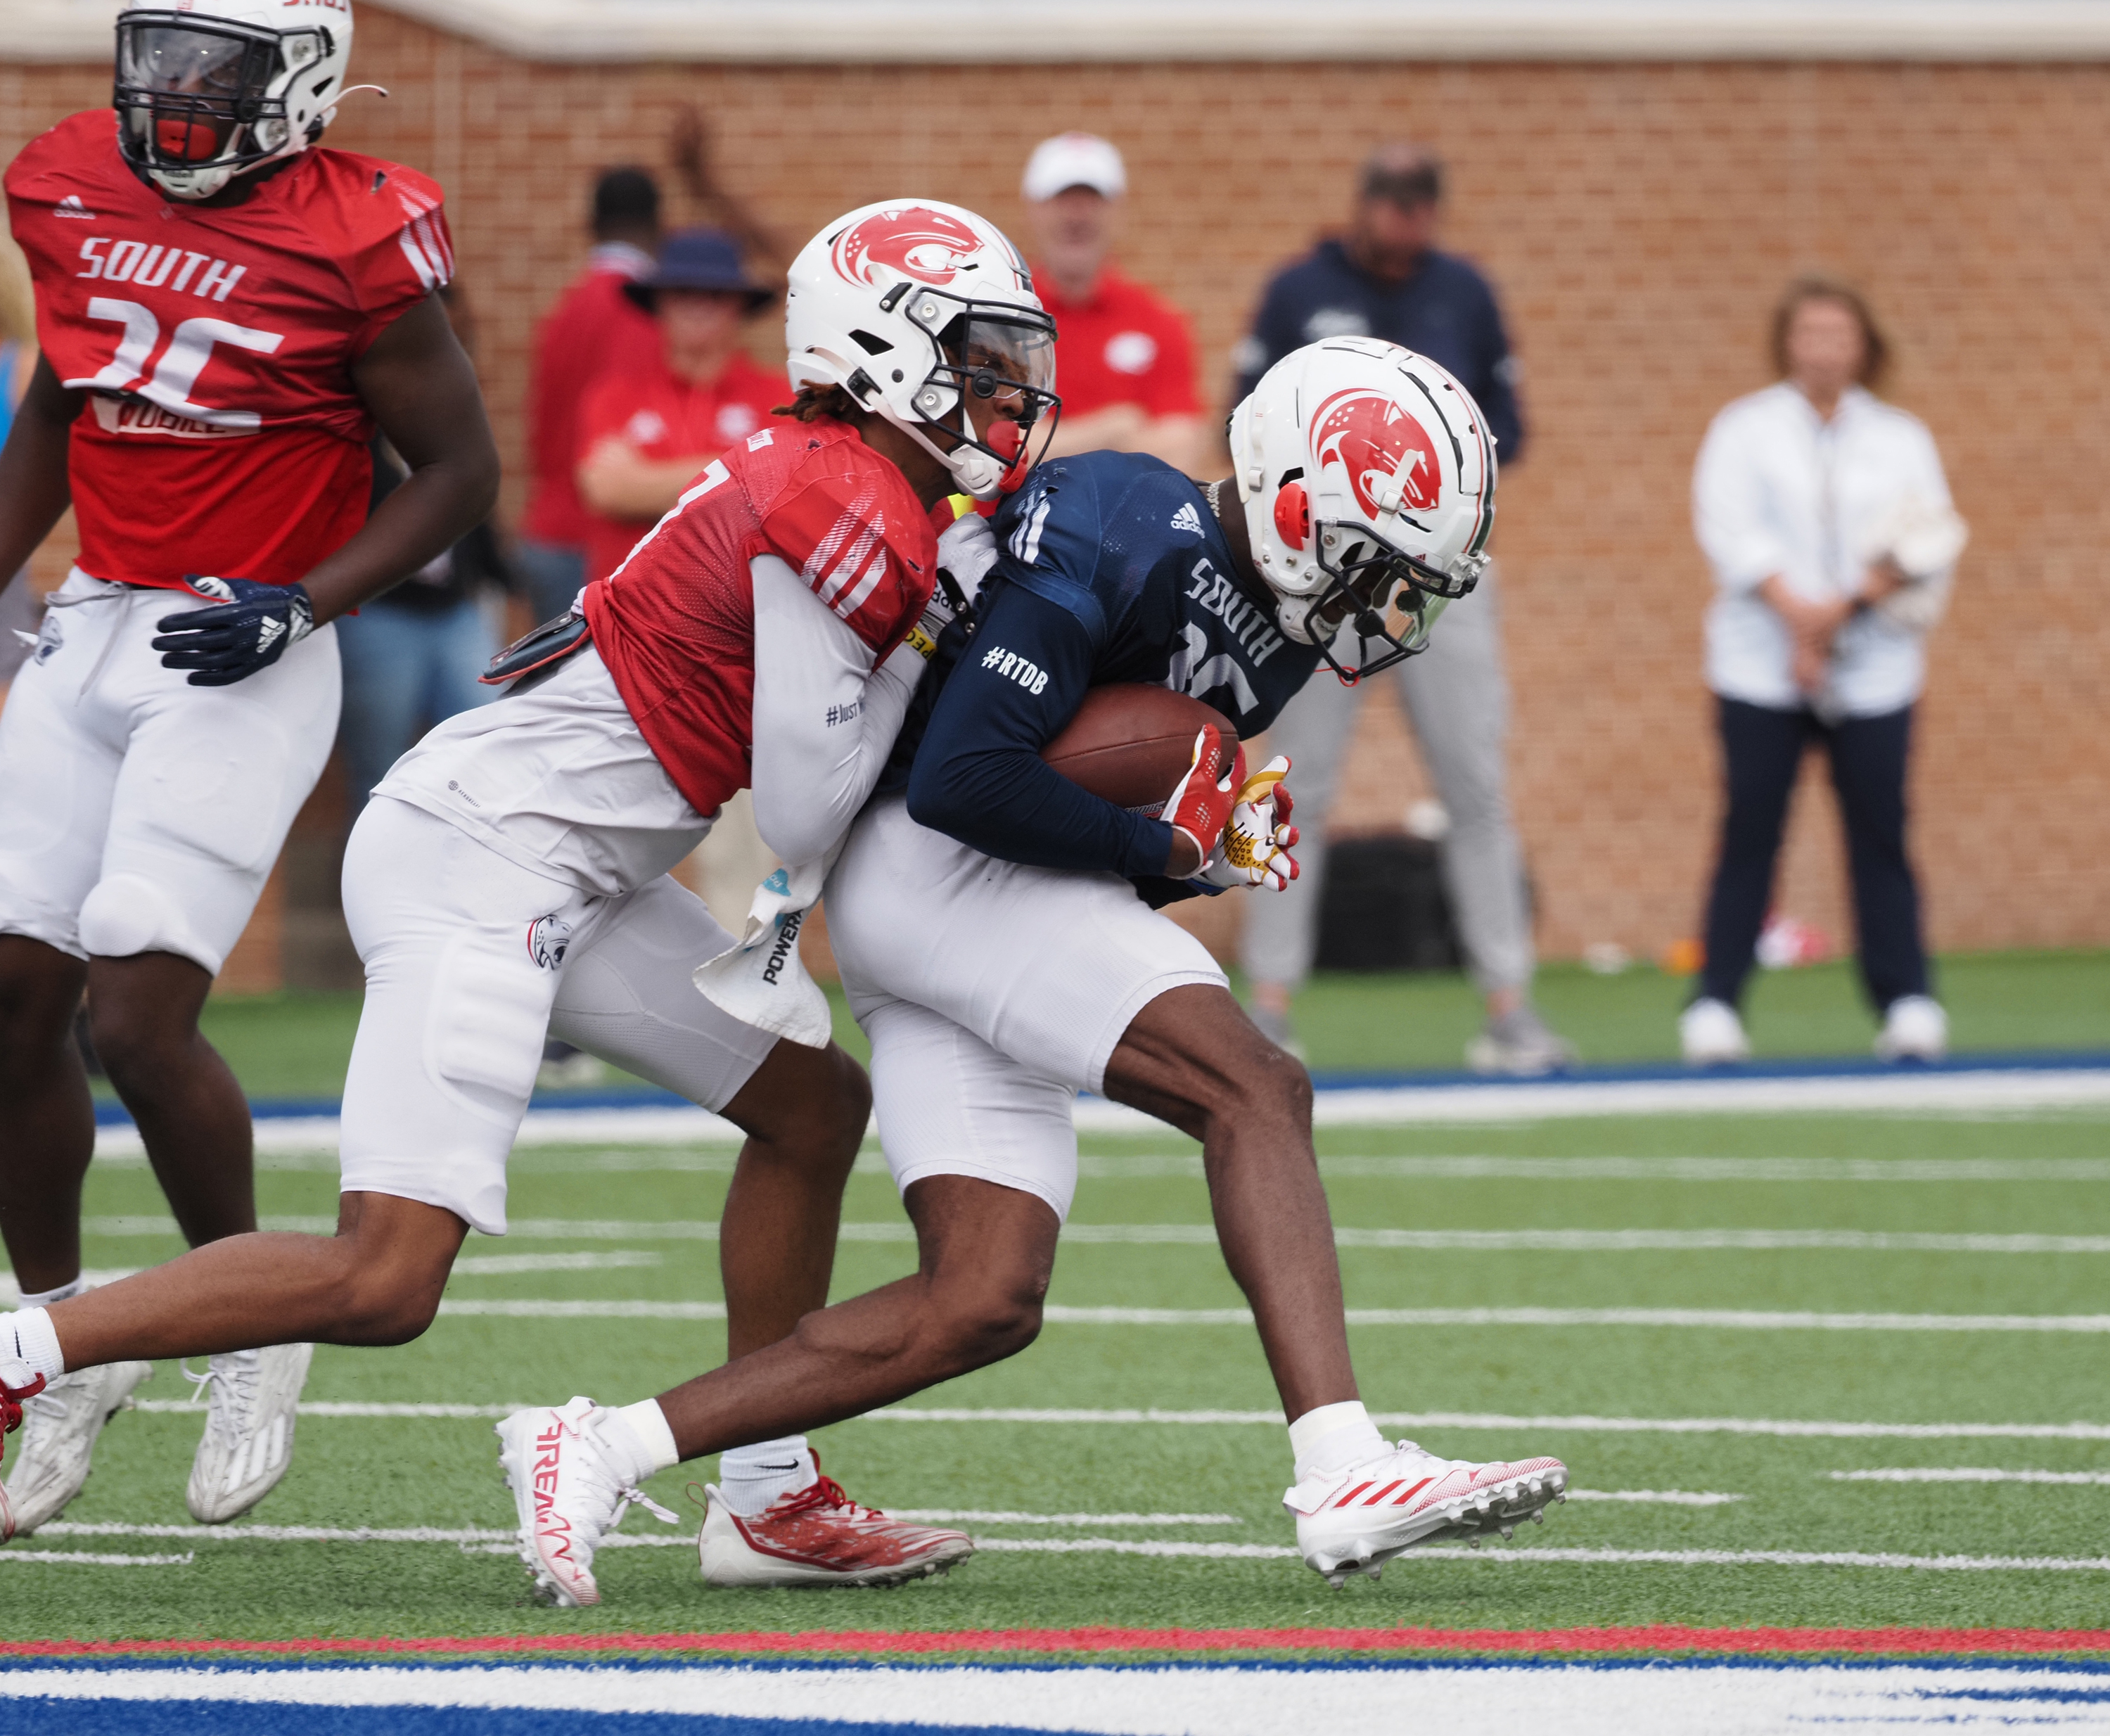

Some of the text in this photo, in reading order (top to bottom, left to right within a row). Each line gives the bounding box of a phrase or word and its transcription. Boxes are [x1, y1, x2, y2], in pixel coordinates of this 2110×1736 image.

[75, 237, 248, 302] SOUTH
[1170, 520, 1206, 540] adidas
[1183, 558, 1285, 668] SOUTH
[981, 646, 1049, 695] #RTDB
